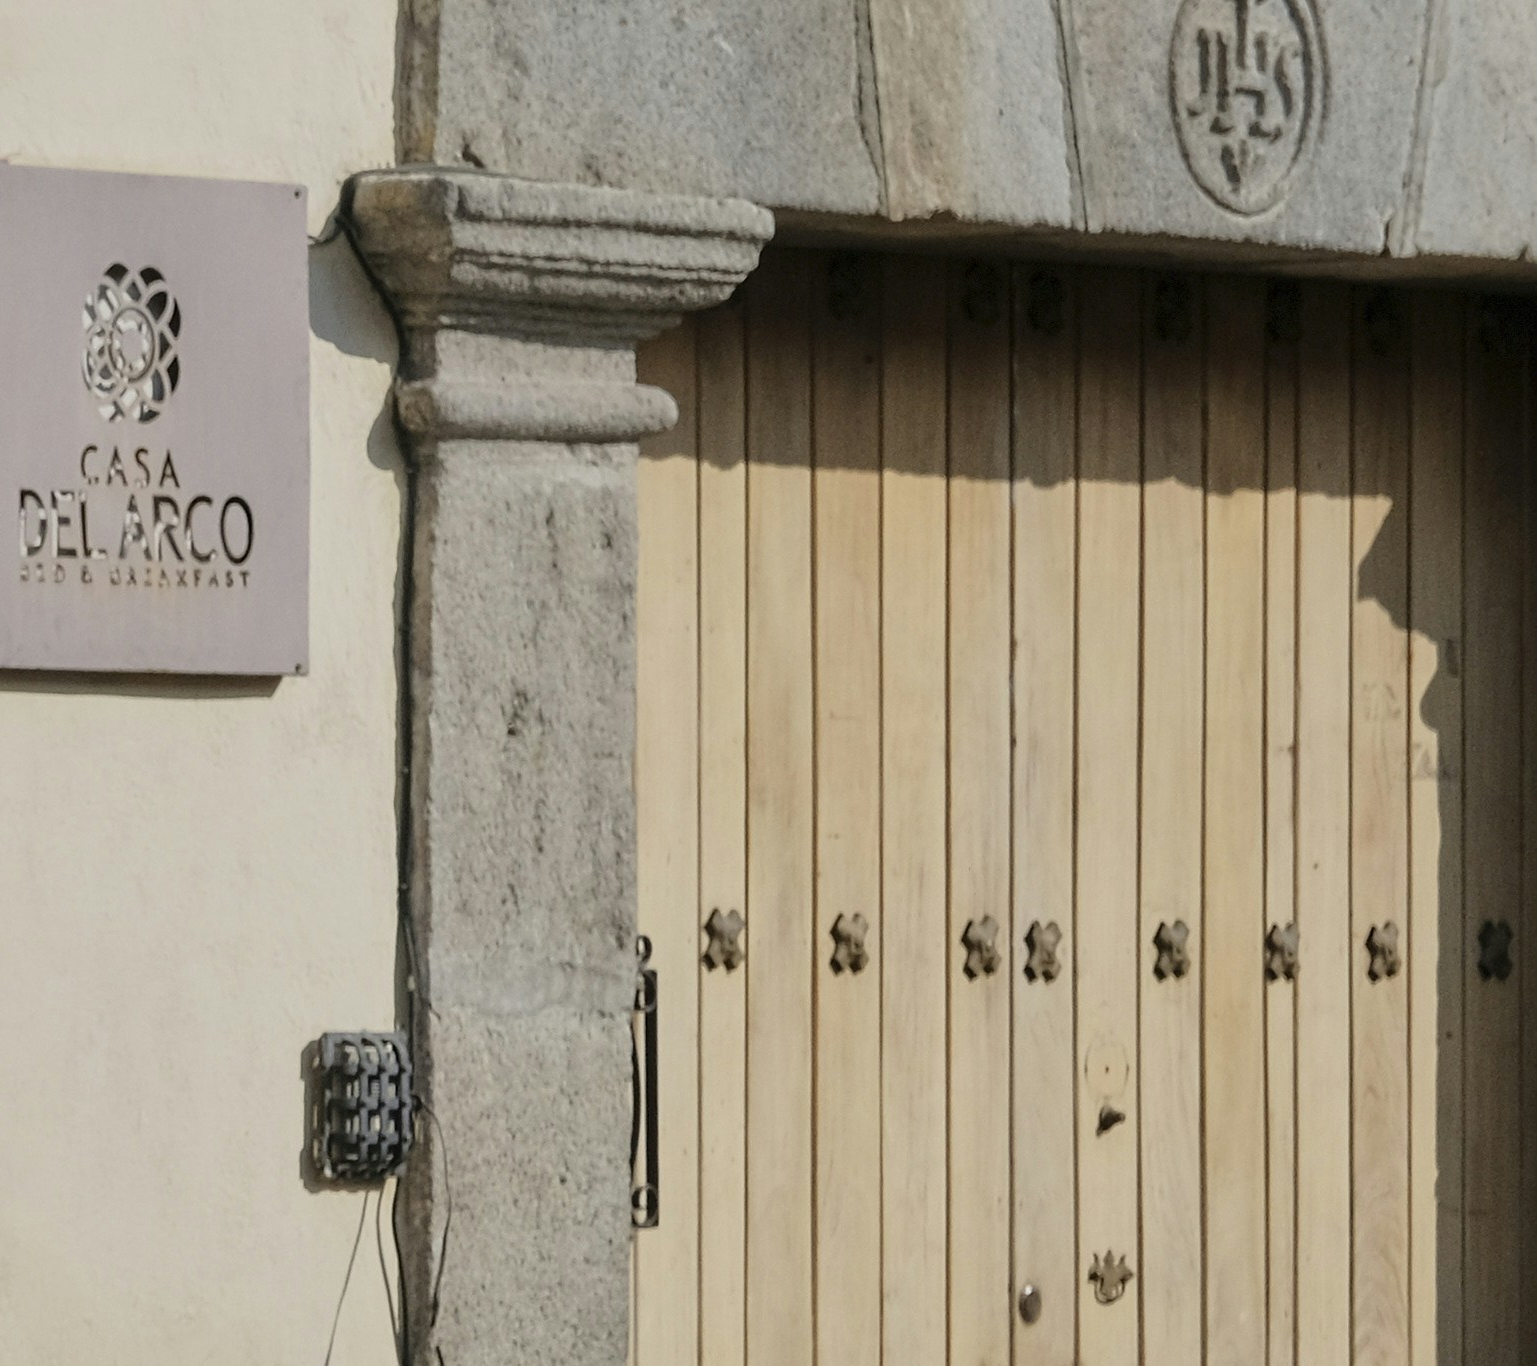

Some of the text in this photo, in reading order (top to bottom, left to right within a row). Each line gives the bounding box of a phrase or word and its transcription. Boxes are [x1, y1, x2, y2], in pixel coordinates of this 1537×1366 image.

[80, 443, 181, 489] CASA
[19, 488, 255, 565] DEL ARCO
